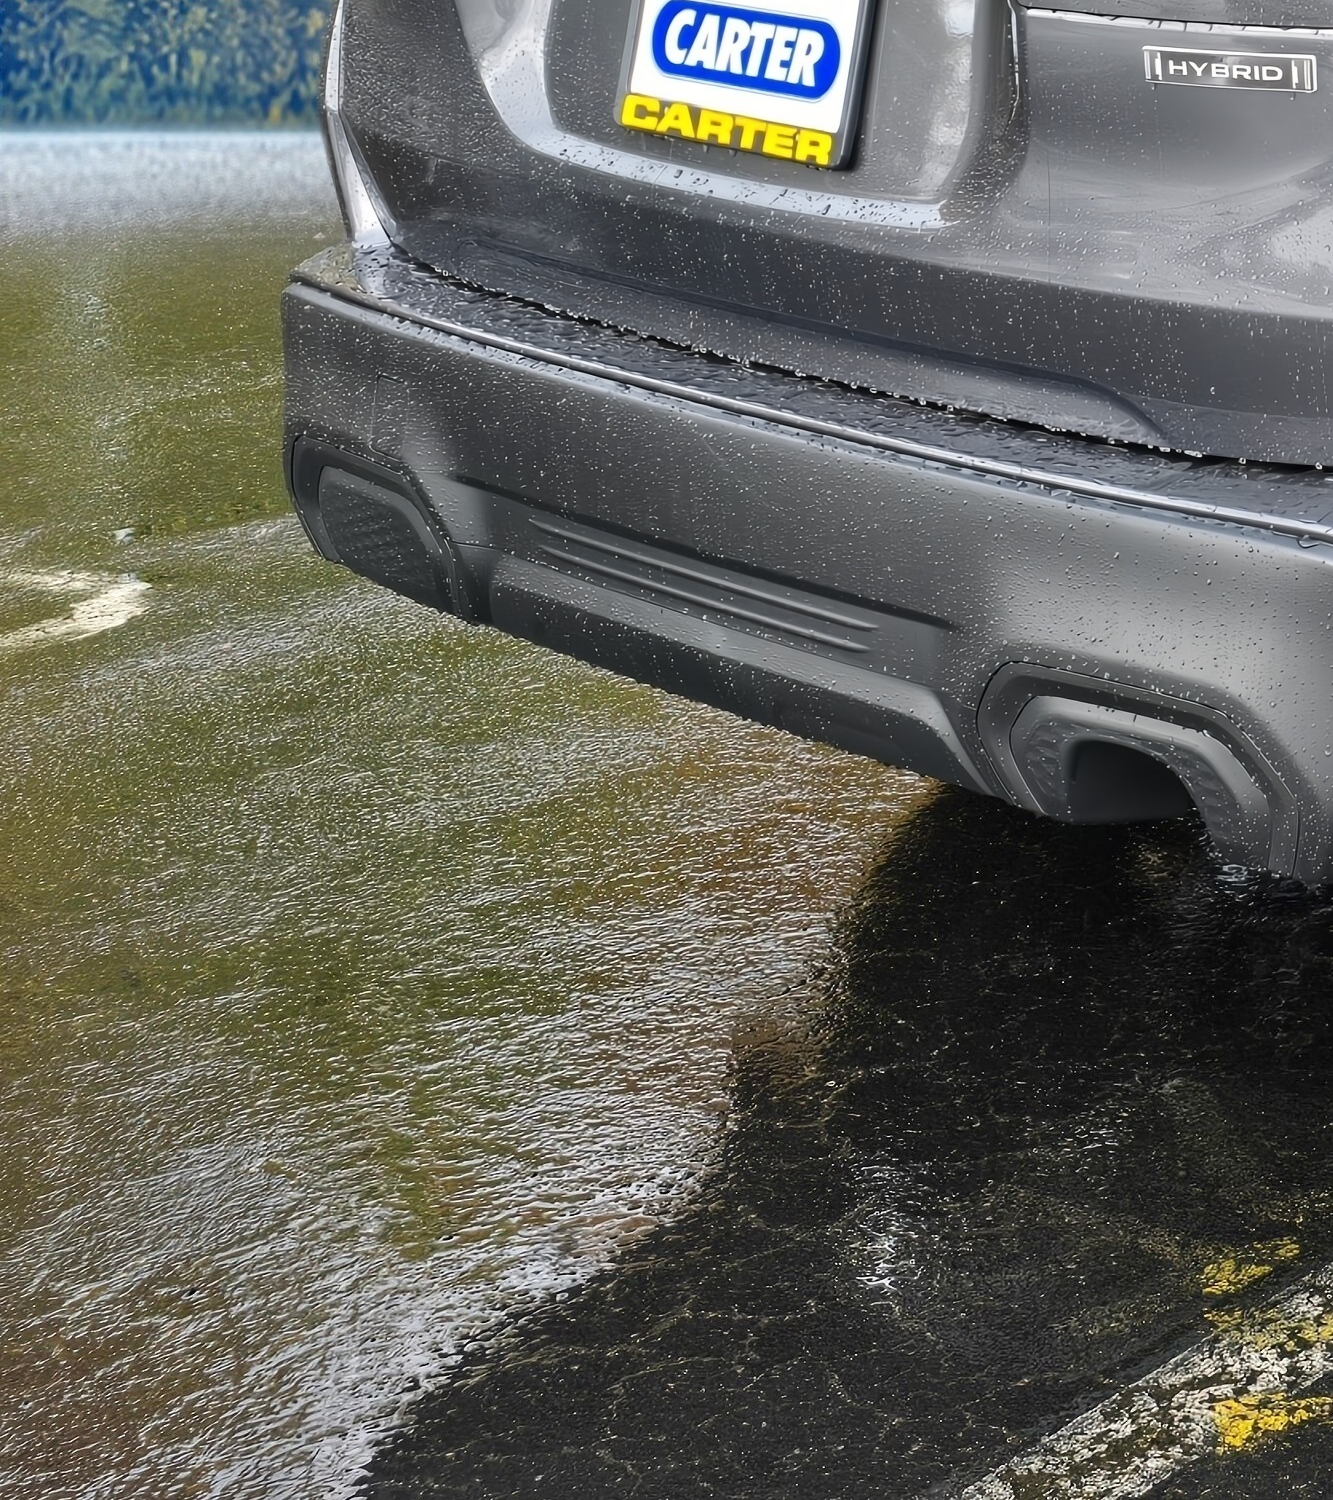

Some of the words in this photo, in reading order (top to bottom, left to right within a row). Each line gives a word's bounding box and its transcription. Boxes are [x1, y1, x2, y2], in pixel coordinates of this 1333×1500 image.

[664, 7, 826, 88] CARTER
[1168, 59, 1284, 81] HYBRID
[620, 93, 833, 166] CARTER
